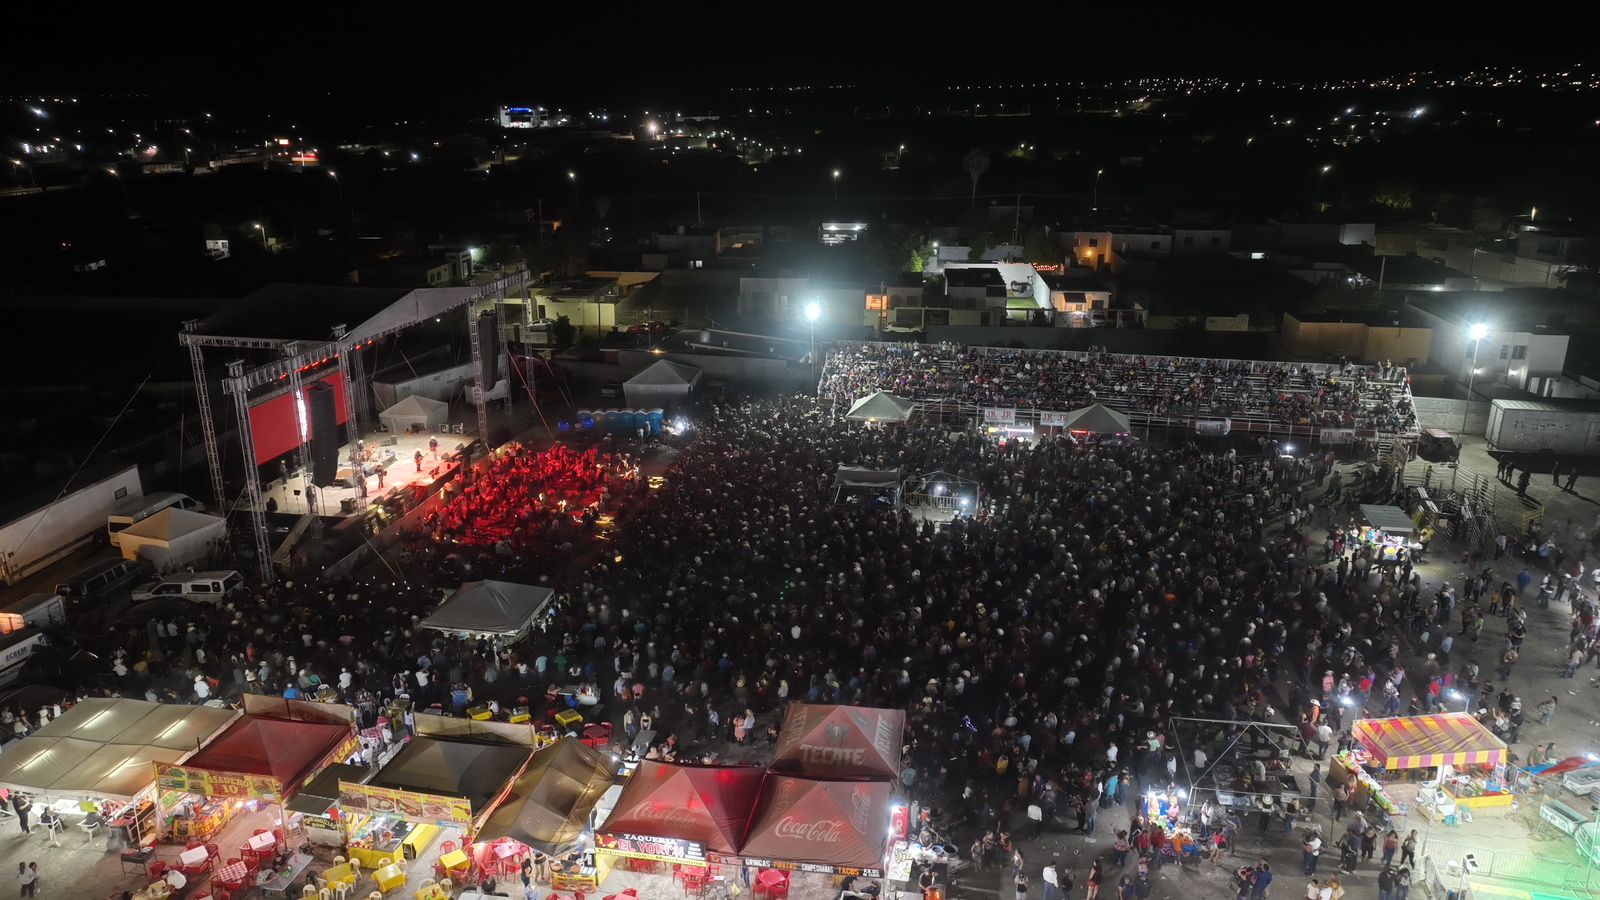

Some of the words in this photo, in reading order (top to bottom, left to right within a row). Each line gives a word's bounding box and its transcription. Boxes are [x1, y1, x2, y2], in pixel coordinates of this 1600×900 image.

[800, 744, 865, 766] TECATE
[222, 785, 240, 794] 10
[775, 815, 842, 842] Coca-Cola
[617, 840, 636, 852] EL
[745, 858, 771, 868] GRINGAS
[838, 866, 859, 876] TACOS
